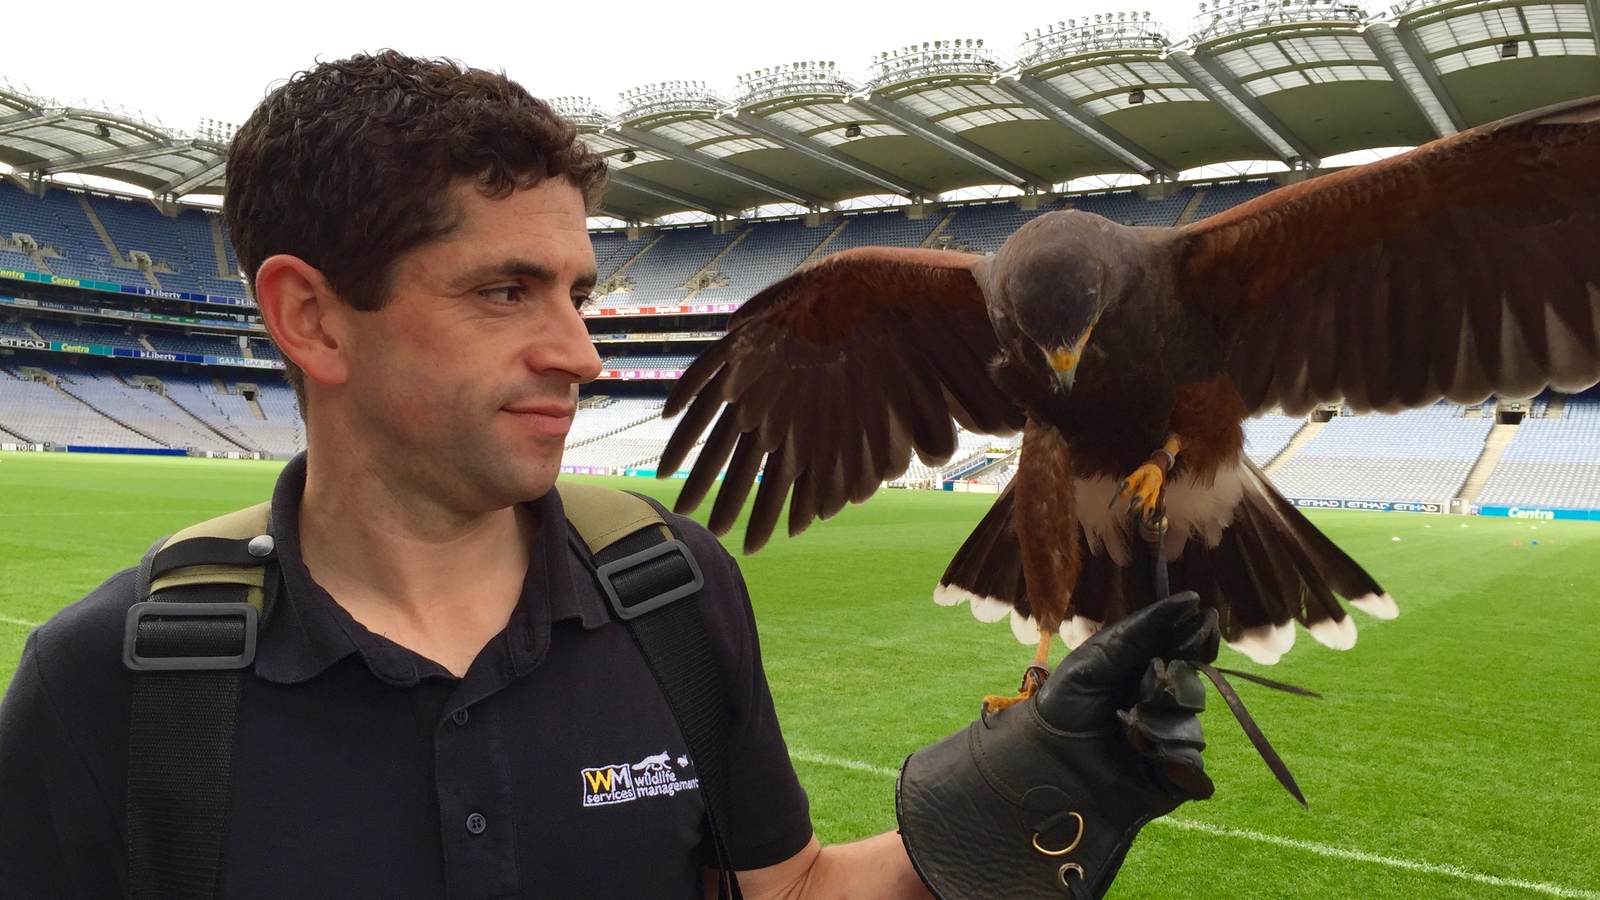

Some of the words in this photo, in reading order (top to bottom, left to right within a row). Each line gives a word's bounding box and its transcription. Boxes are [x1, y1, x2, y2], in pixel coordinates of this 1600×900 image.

[0, 269, 25, 280] entra
[51, 275, 80, 287] Centra
[61, 343, 90, 353] Centra
[1298, 499, 1339, 508] ETIHAD
[1347, 501, 1390, 510] ETIHAD
[1393, 503, 1438, 512] ETIHAD
[1508, 507, 1555, 520] Centra
[585, 767, 631, 794] WM
[634, 770, 677, 787] wildlife
[636, 777, 699, 798] management
[586, 788, 634, 803] services
